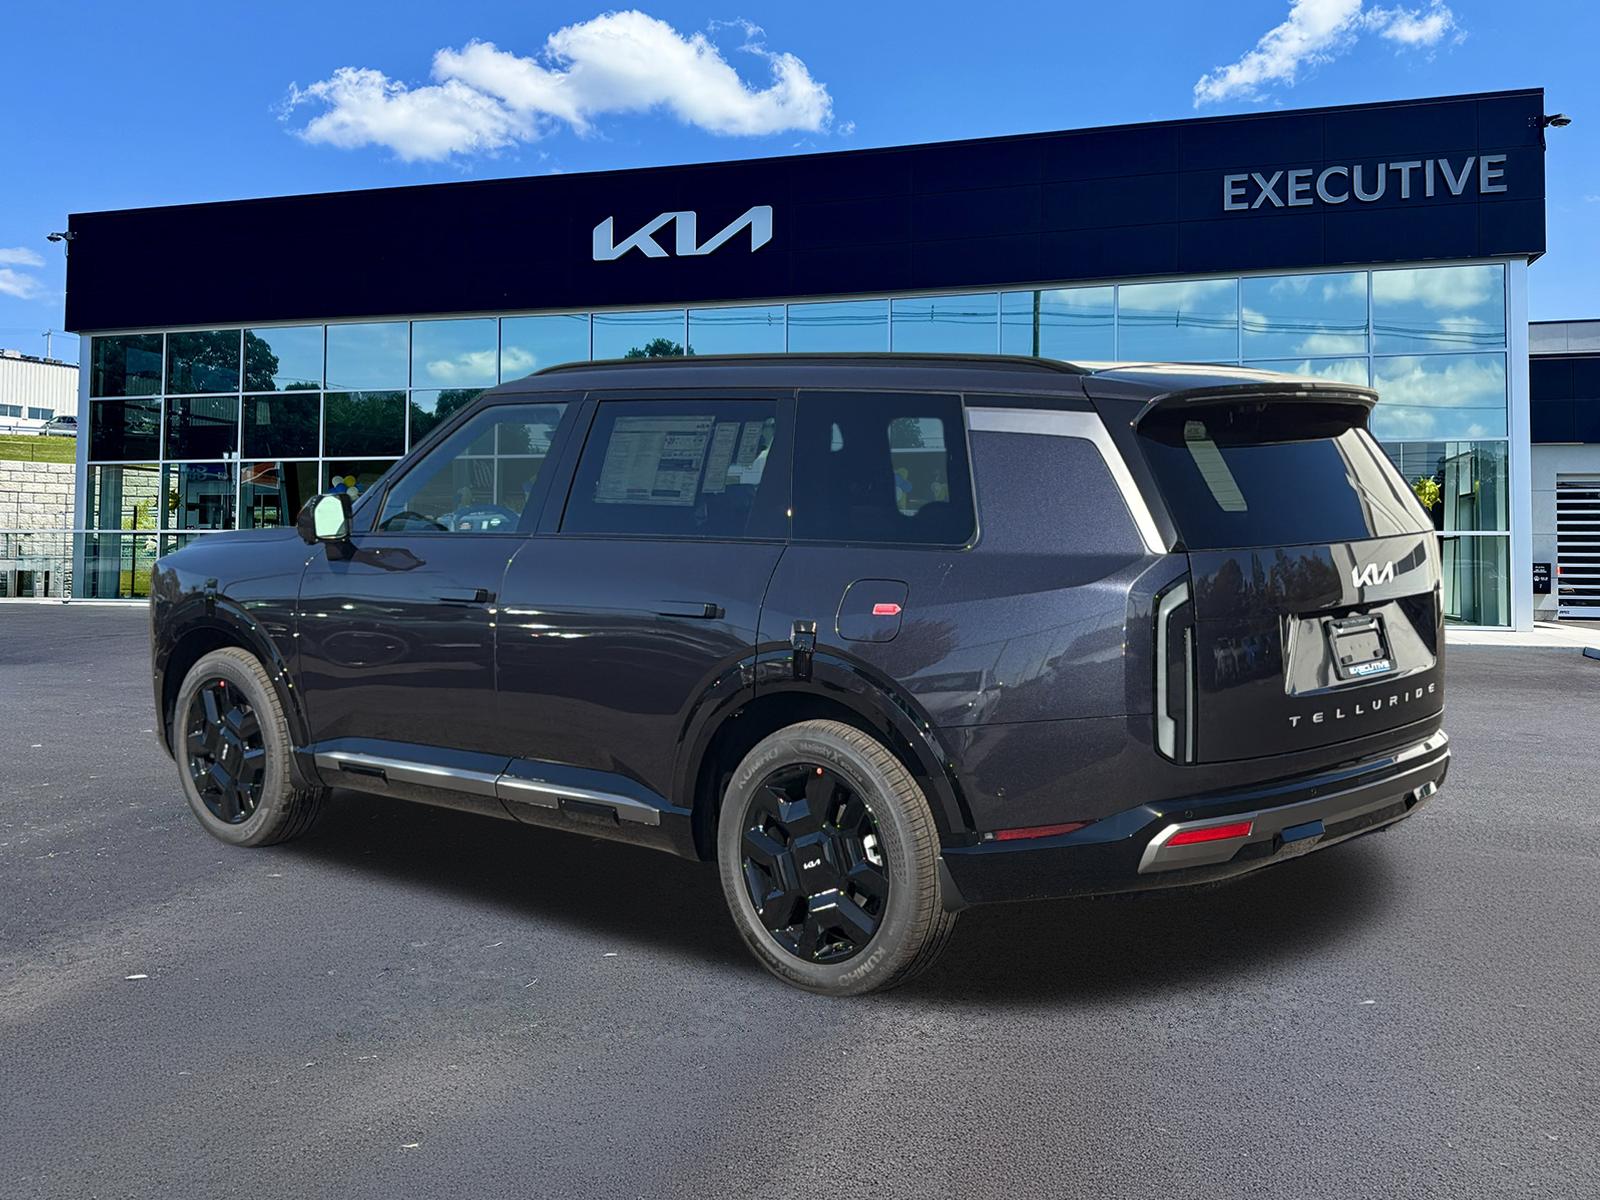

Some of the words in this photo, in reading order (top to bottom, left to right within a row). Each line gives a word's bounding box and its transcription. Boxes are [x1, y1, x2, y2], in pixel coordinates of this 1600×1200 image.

[1224, 155, 1508, 211] EXECUTIVE
[593, 205, 773, 261] KIA
[1351, 561, 1394, 588] KIA
[1289, 683, 1436, 728] TELLURIDE
[803, 858, 821, 870] KIA
[837, 945, 887, 987] KUMHO
